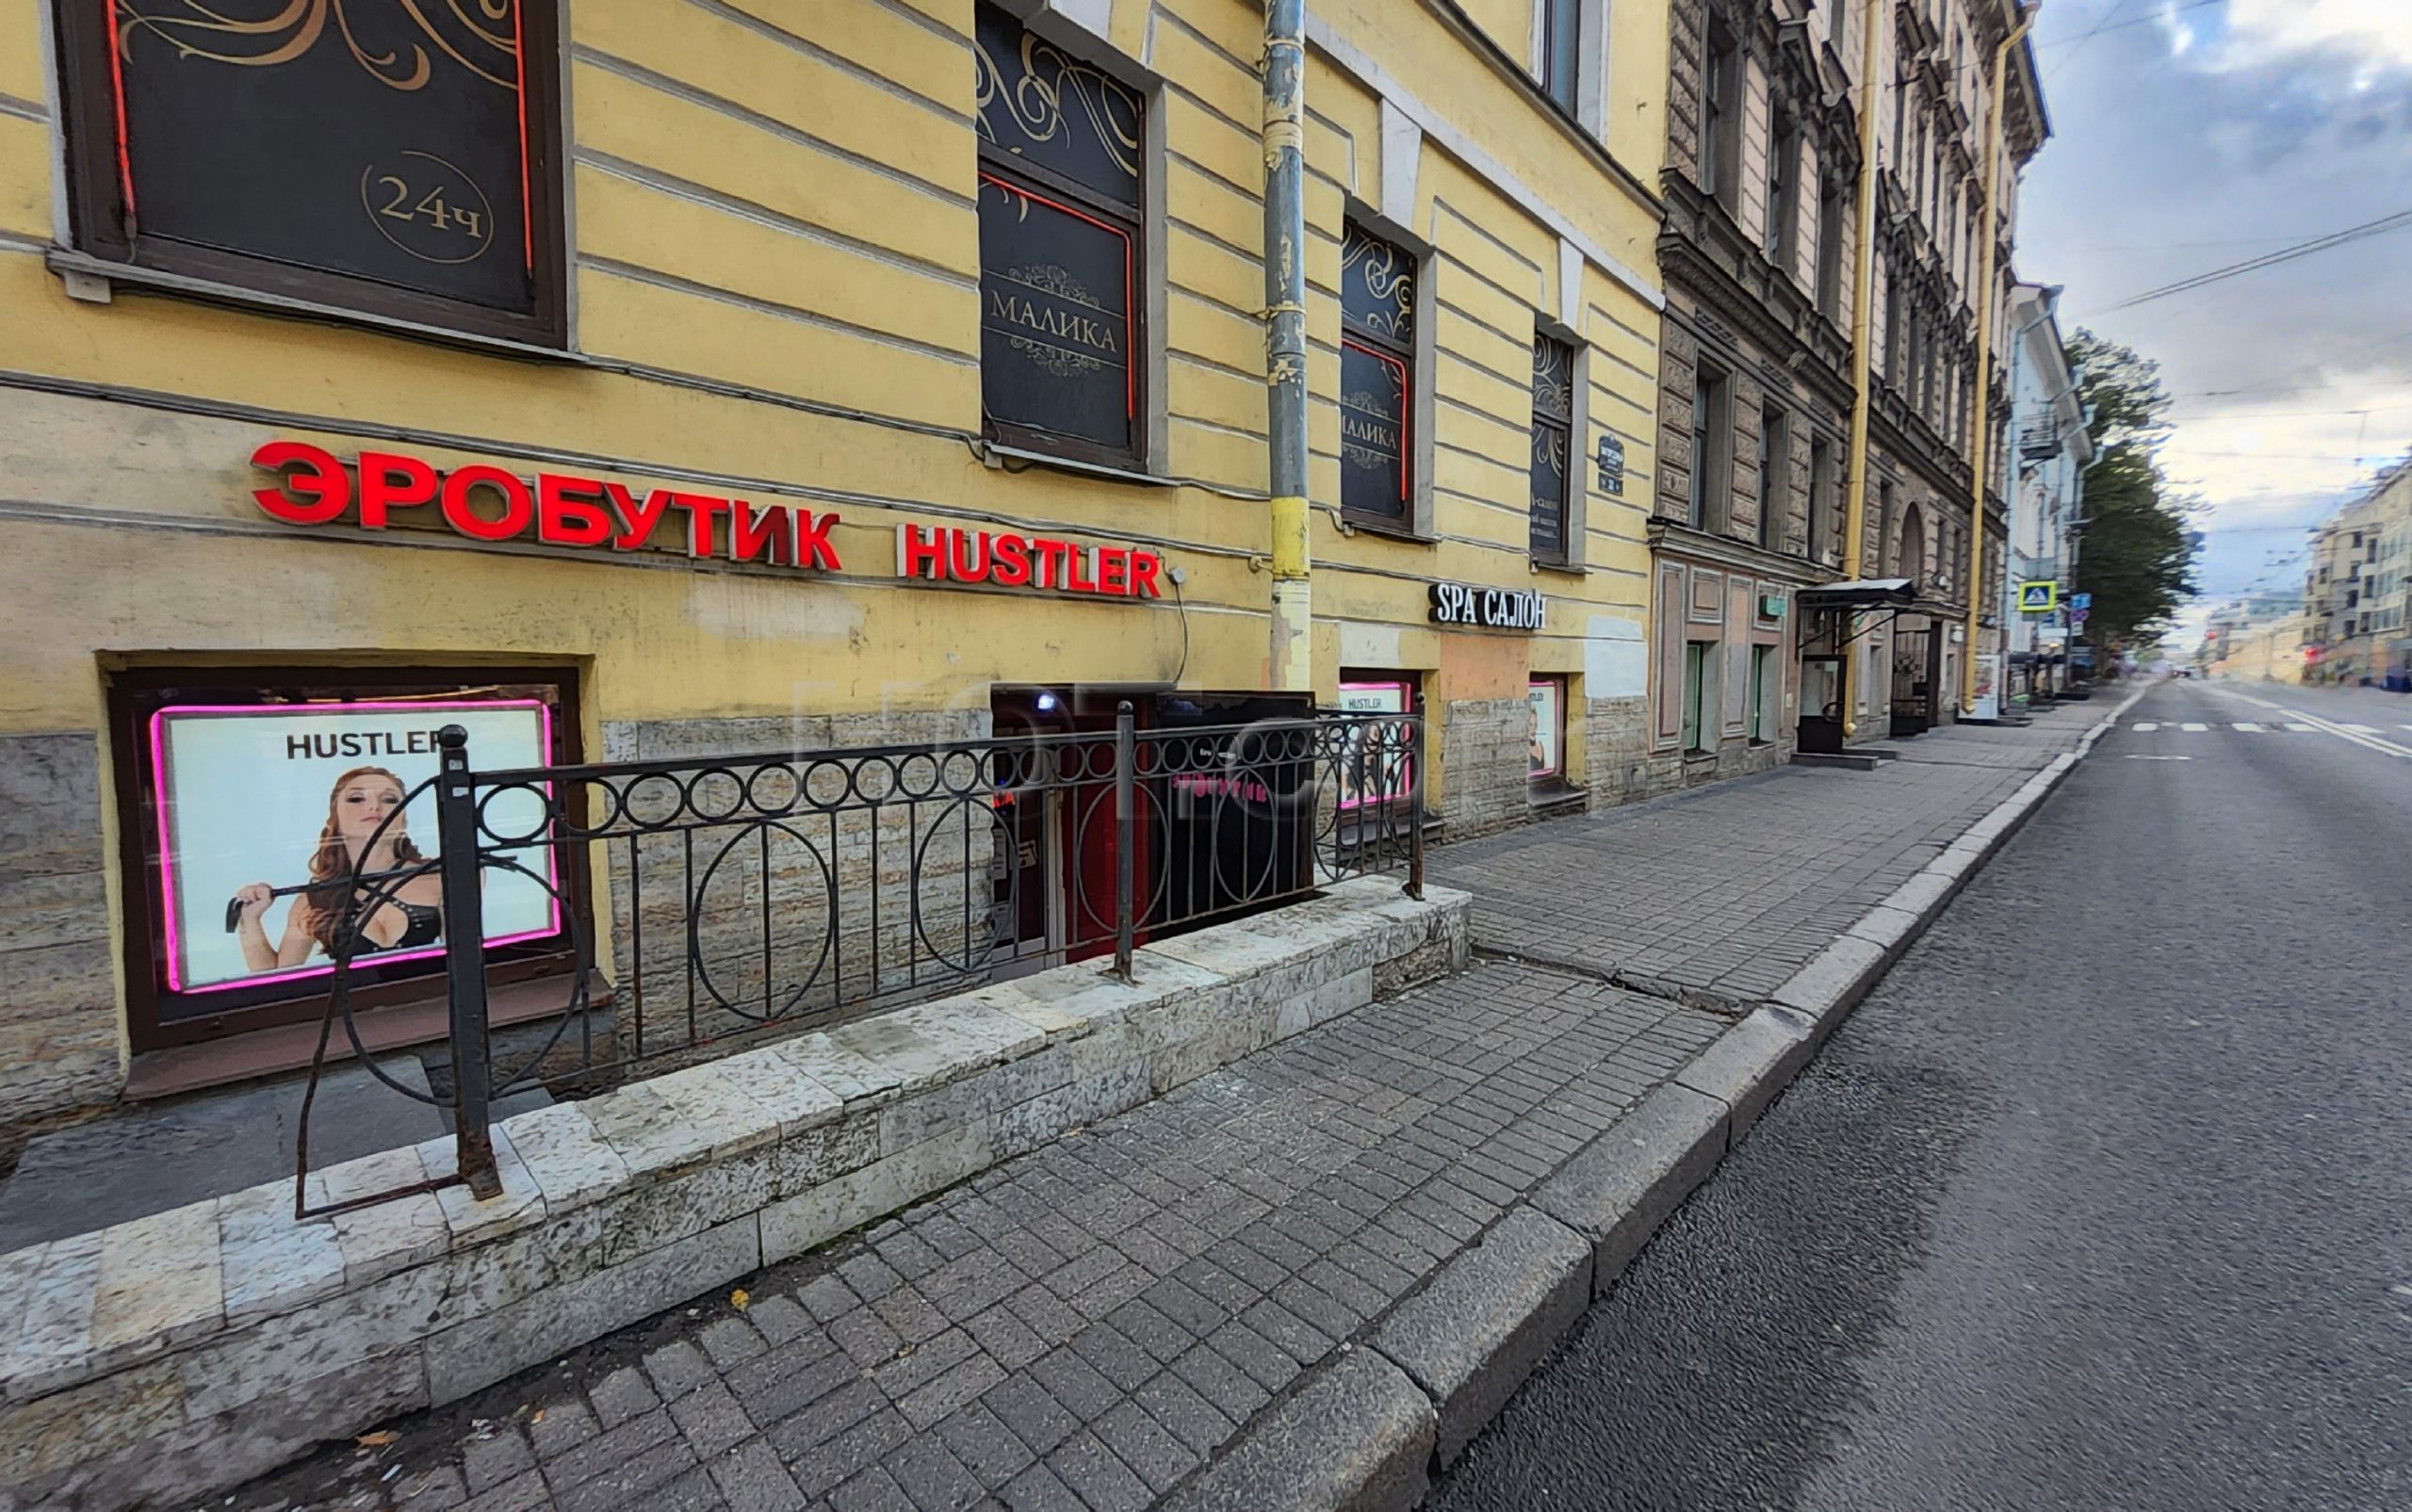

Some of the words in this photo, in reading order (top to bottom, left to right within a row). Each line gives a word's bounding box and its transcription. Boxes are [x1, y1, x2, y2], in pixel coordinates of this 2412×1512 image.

[990, 288, 1117, 354] МАЛИКА
[250, 439, 842, 571] ЭРОБУТИК
[896, 522, 1161, 598] HUSTLER
[1435, 582, 1477, 623] SPA
[1483, 589, 1547, 629] САЛОН
